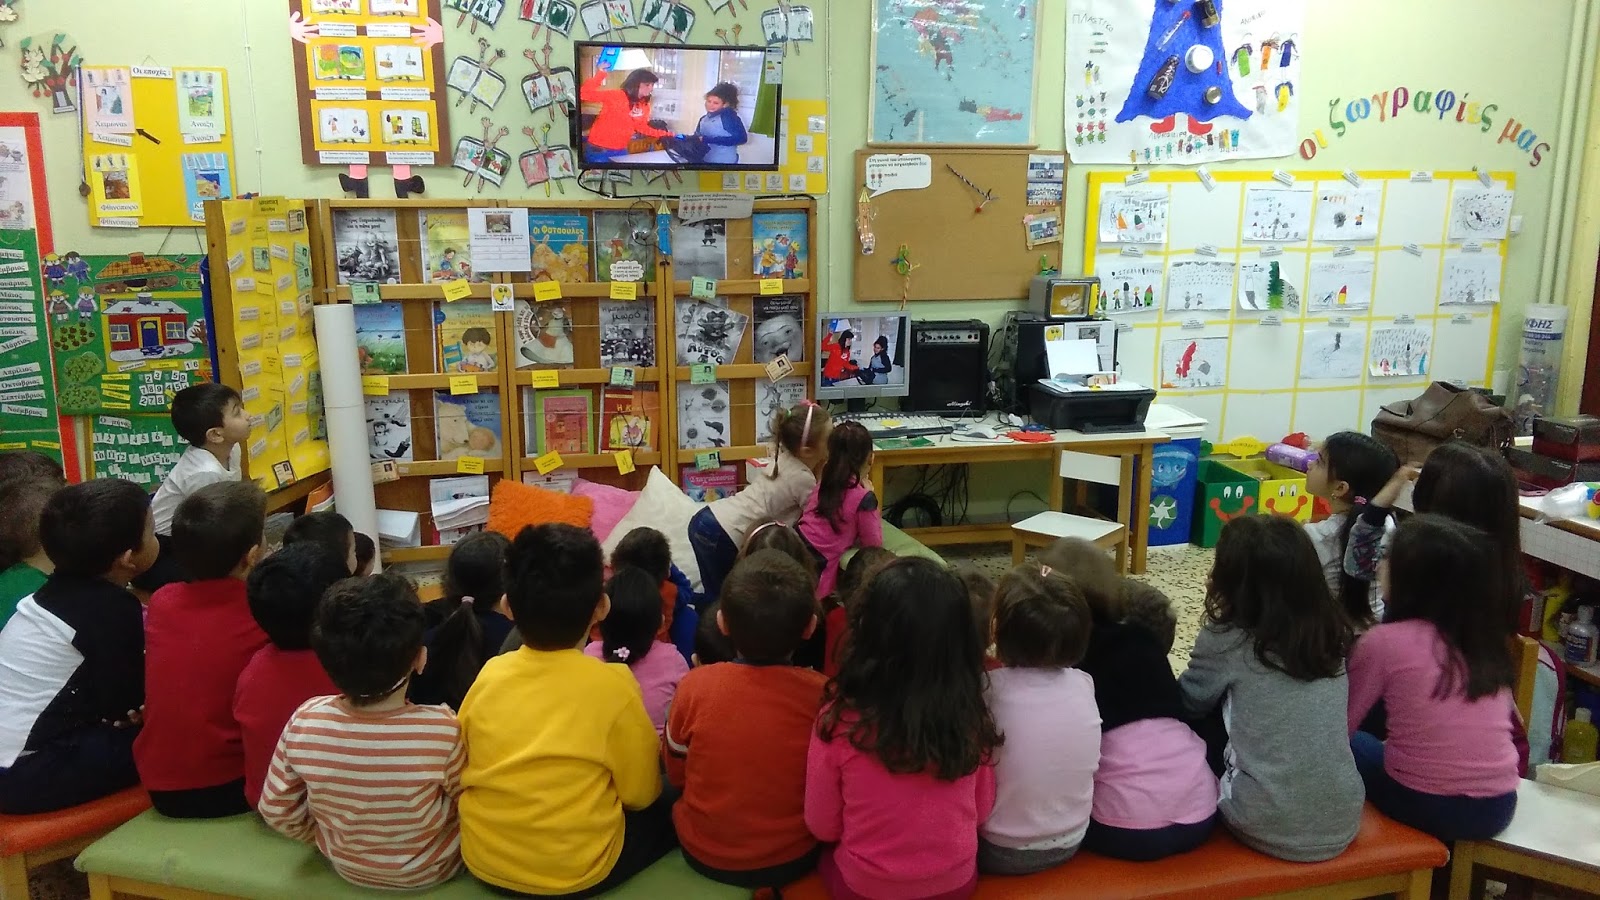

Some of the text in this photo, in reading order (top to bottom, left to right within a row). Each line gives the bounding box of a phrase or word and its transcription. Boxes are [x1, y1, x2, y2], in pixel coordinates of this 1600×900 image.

[1300, 86, 1550, 167] οι ζωγραφίες μας
